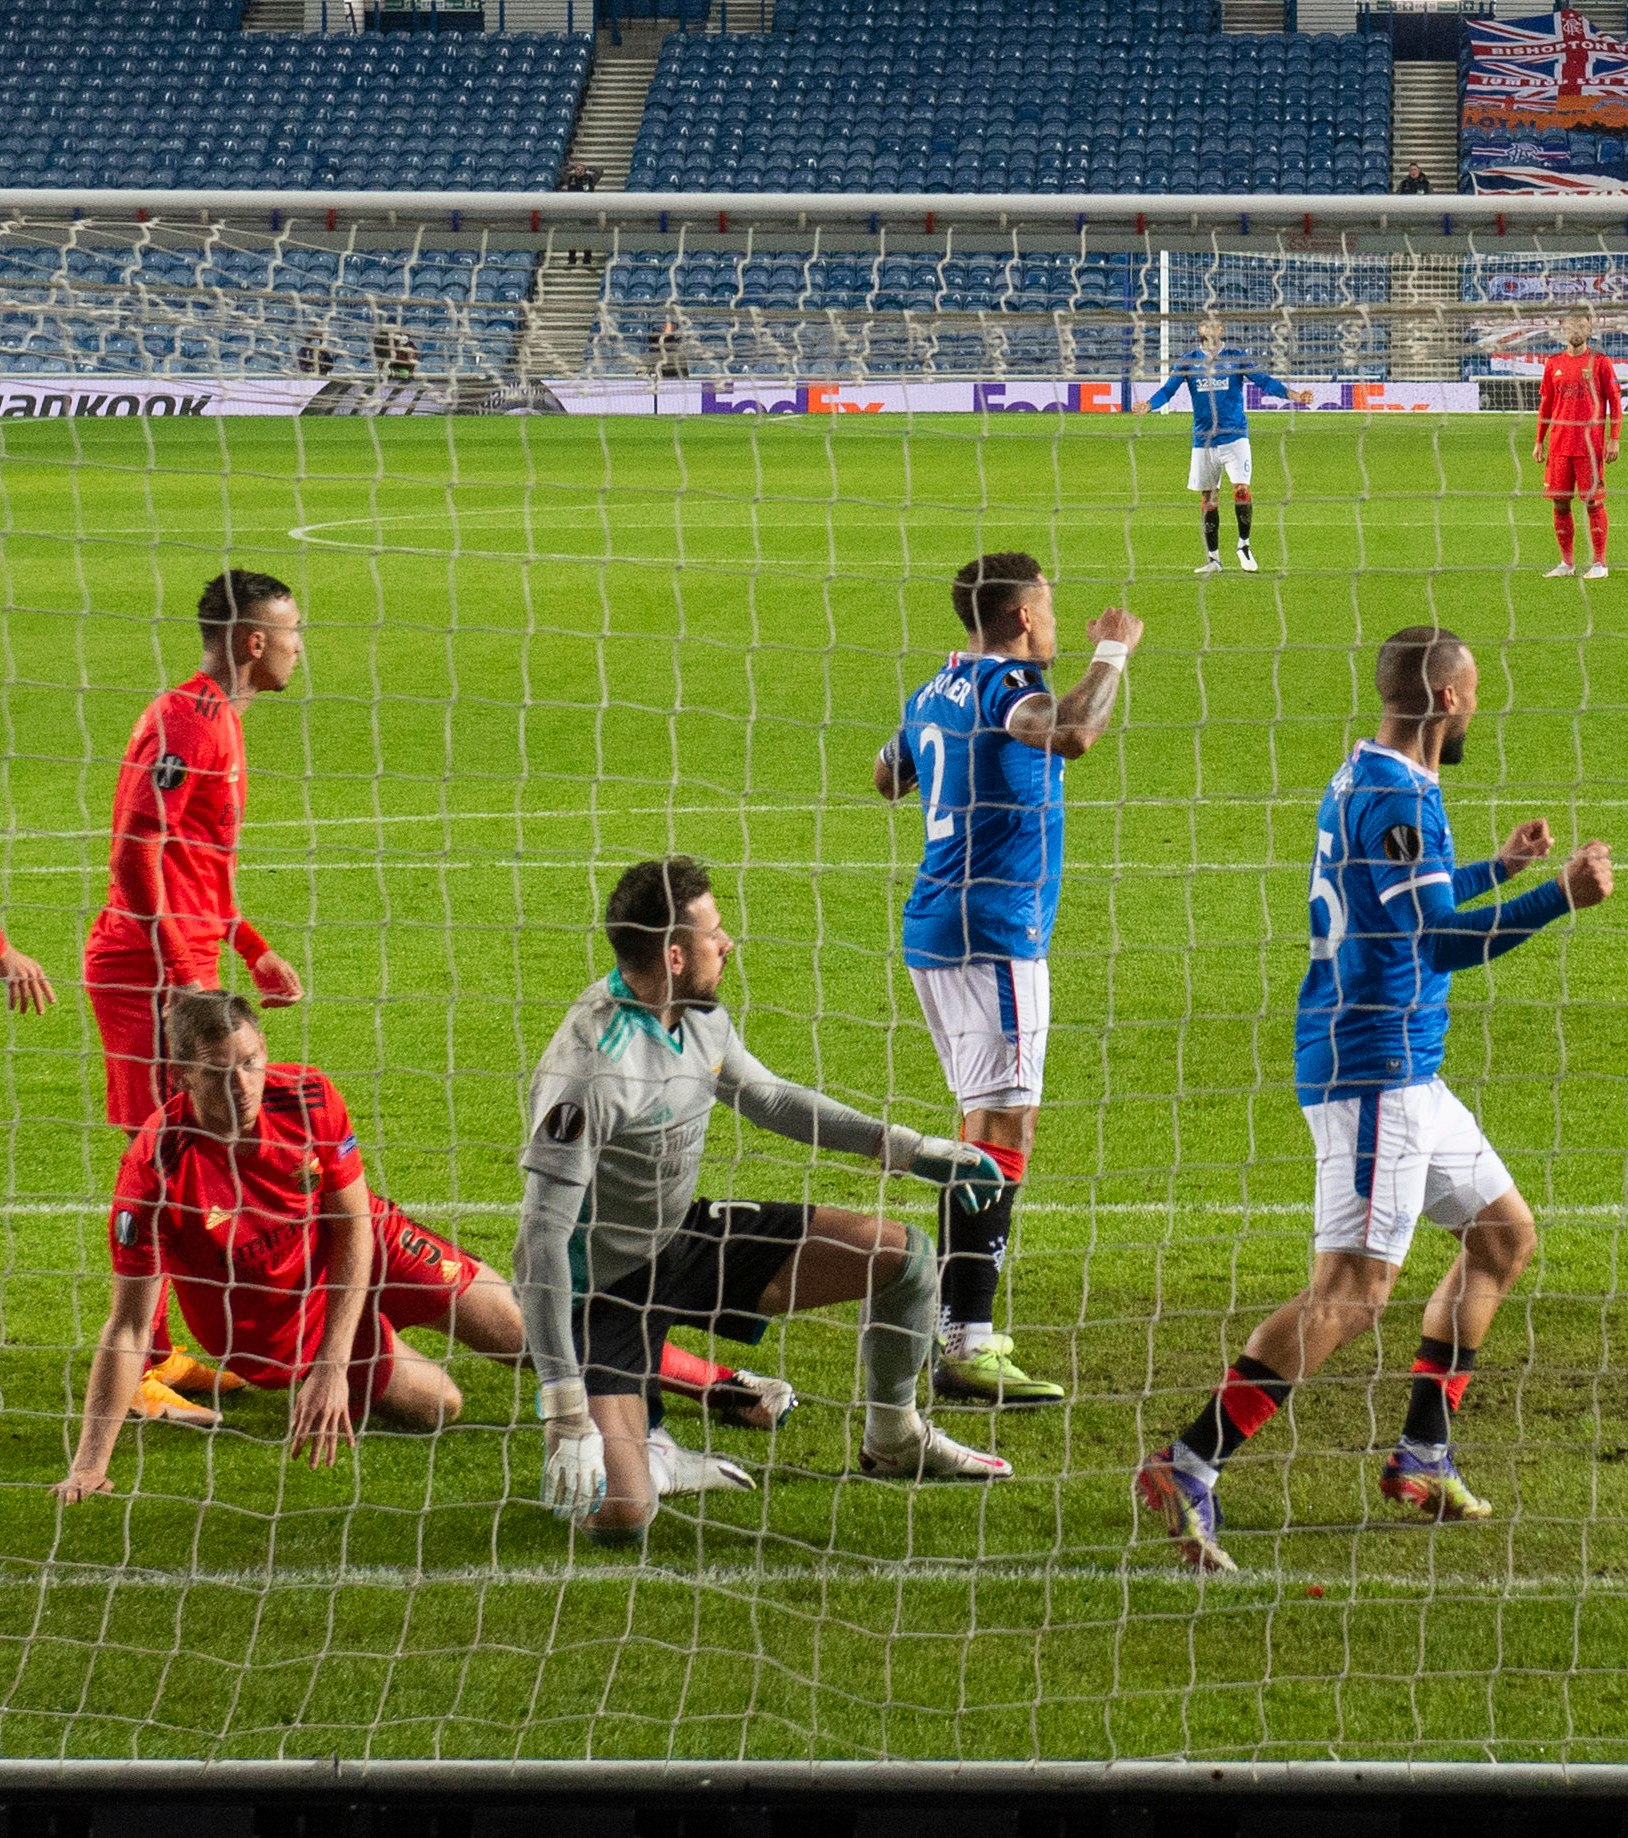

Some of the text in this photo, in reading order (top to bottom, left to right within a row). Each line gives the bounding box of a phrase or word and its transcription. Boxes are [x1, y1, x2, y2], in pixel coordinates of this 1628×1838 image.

[1491, 41, 1608, 56] BISHOPTON
[701, 382, 885, 413] FedEx
[1196, 377, 1230, 388] 32Red
[919, 722, 955, 842] 2
[401, 1229, 442, 1265] 5
